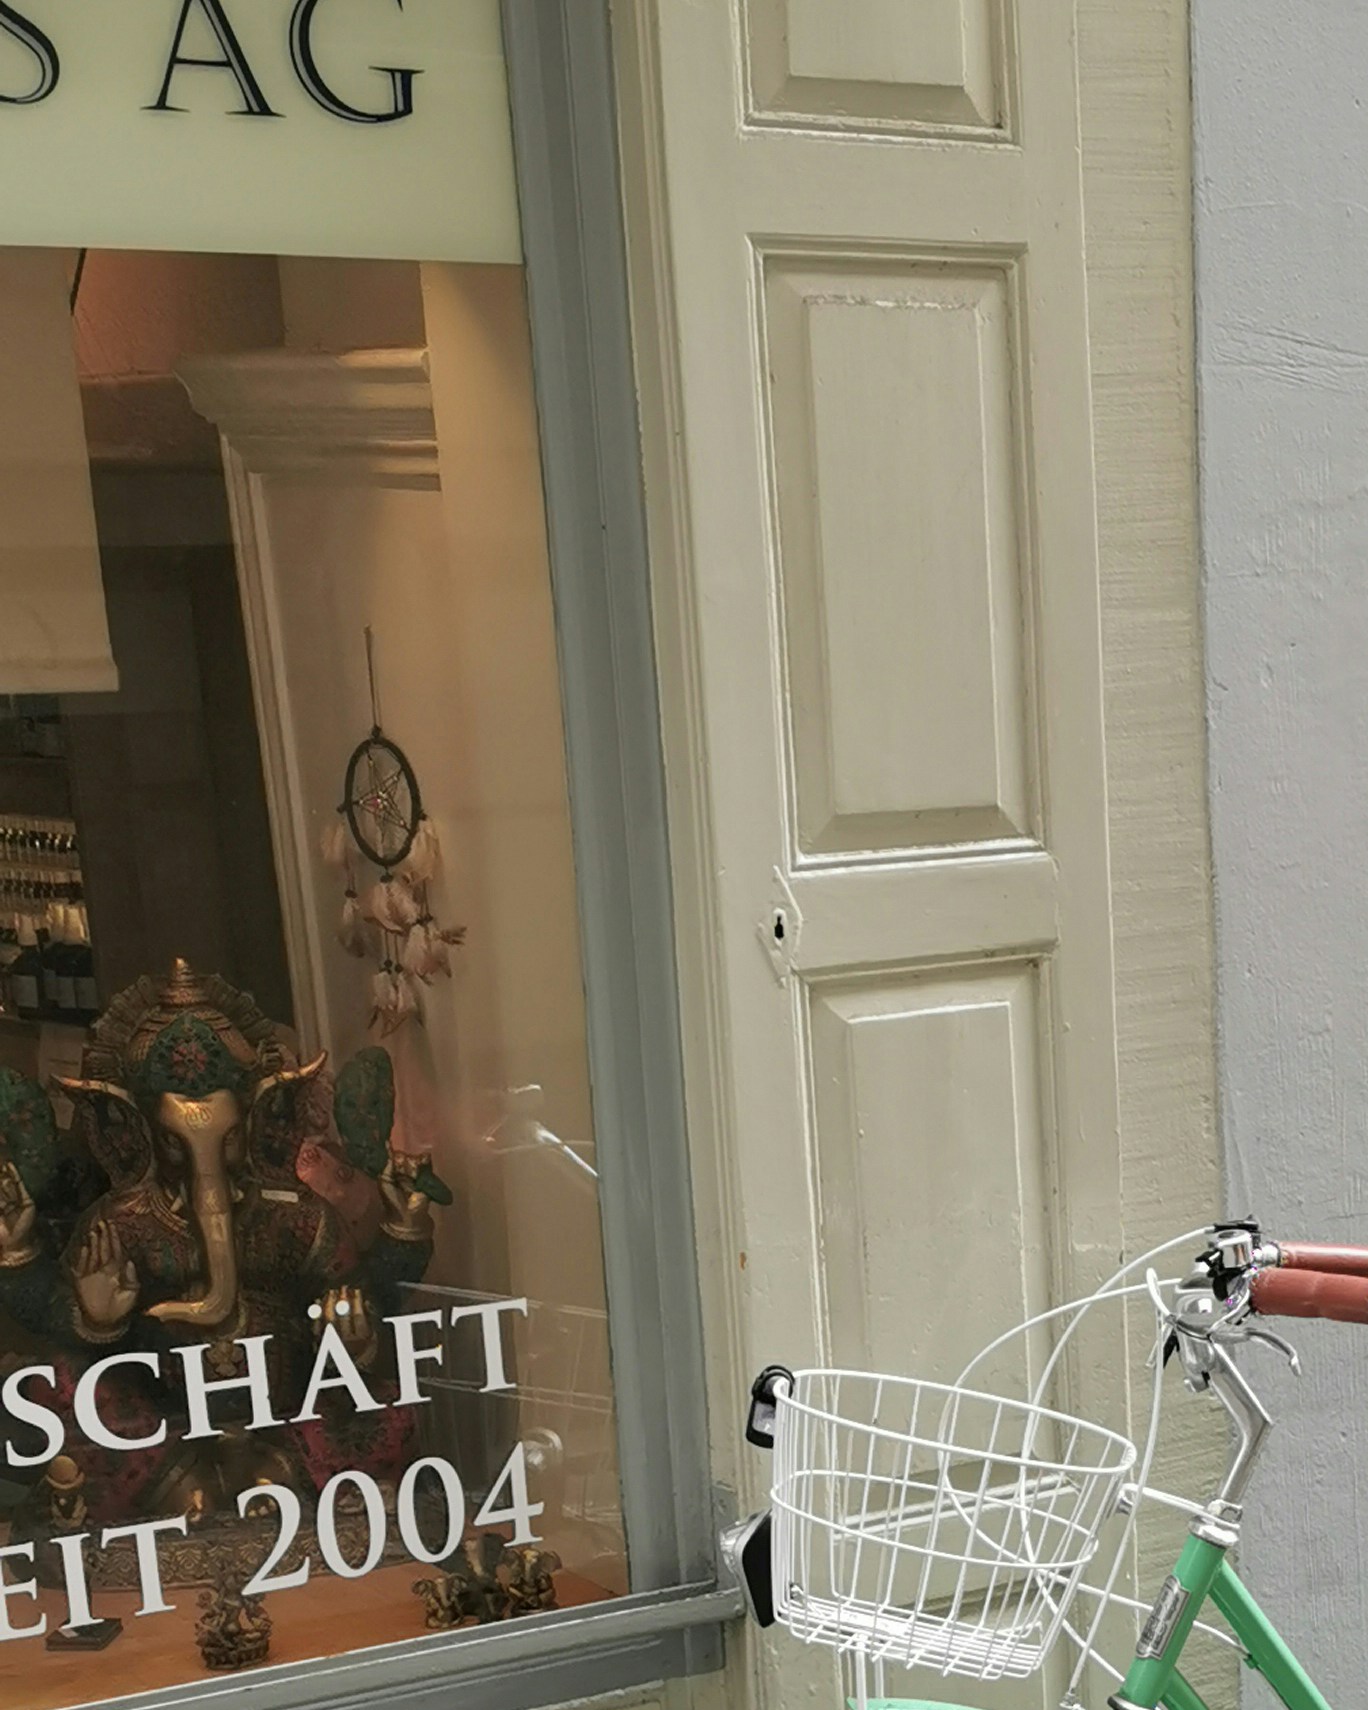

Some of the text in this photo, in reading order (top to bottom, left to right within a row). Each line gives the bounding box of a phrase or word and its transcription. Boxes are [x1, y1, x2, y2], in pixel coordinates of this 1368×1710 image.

[140, 0, 425, 123] AG
[2, 1297, 528, 1467] SCHÄFT
[0, 1441, 544, 1641] EIT 2004
